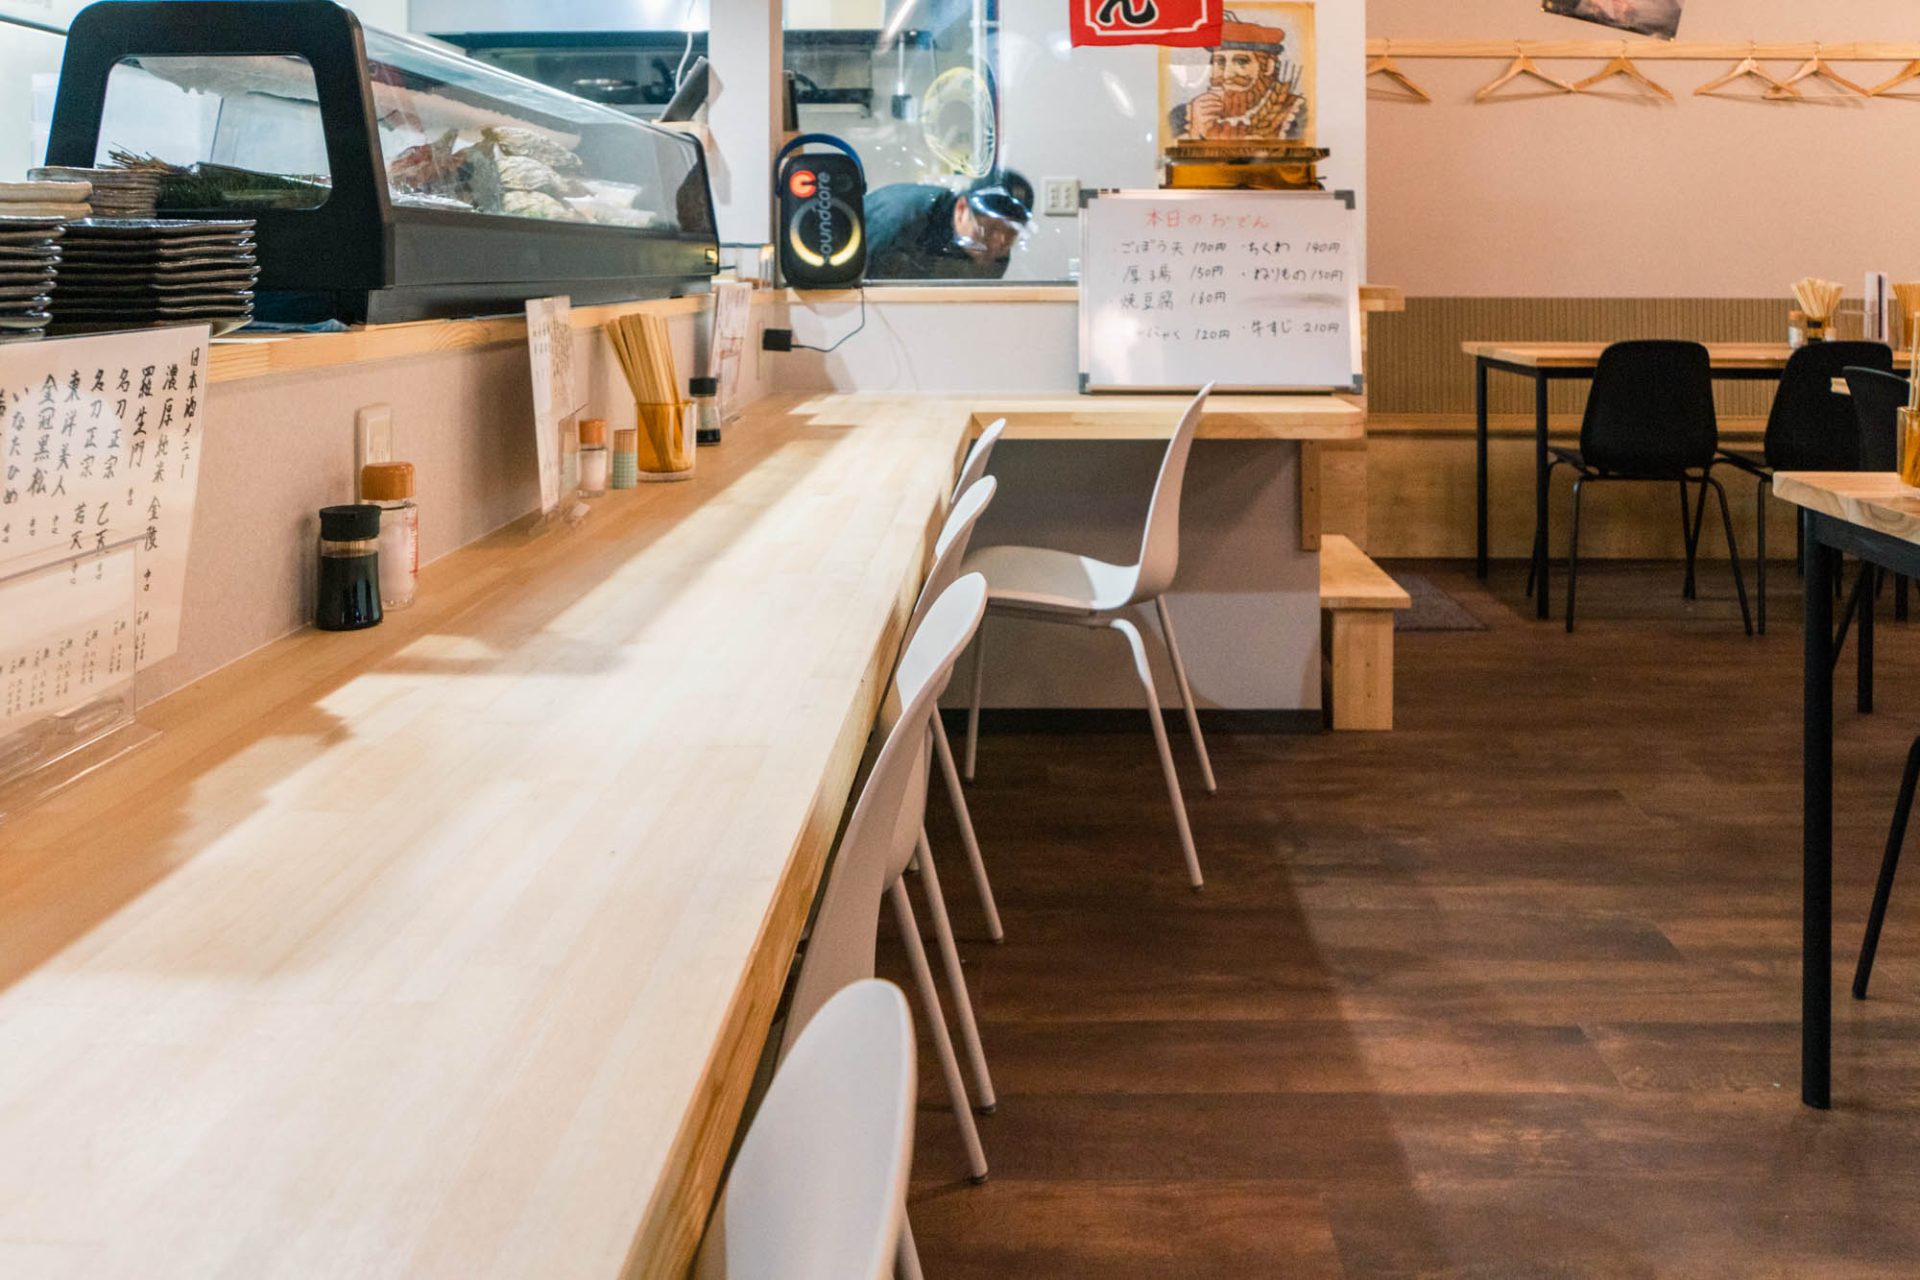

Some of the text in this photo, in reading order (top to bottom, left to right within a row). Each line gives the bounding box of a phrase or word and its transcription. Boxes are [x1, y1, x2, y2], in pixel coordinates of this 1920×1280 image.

[1120, 239, 1185, 257] ごぼう天
[1145, 208, 1270, 230] 本日のおでん
[1247, 240, 1291, 255] ちくわ
[1253, 266, 1307, 283] ねりもの
[1194, 328, 1231, 342] 120円
[1250, 319, 1340, 338] 牛すじ 210円
[26, 373, 58, 498] 金冠黒松
[50, 368, 82, 498] 東洋美人
[79, 368, 105, 479] 名刀正宗
[103, 367, 131, 480] 名刀正宗
[128, 364, 156, 469] 羅生門
[180, 346, 201, 479] 日本酒メニュー
